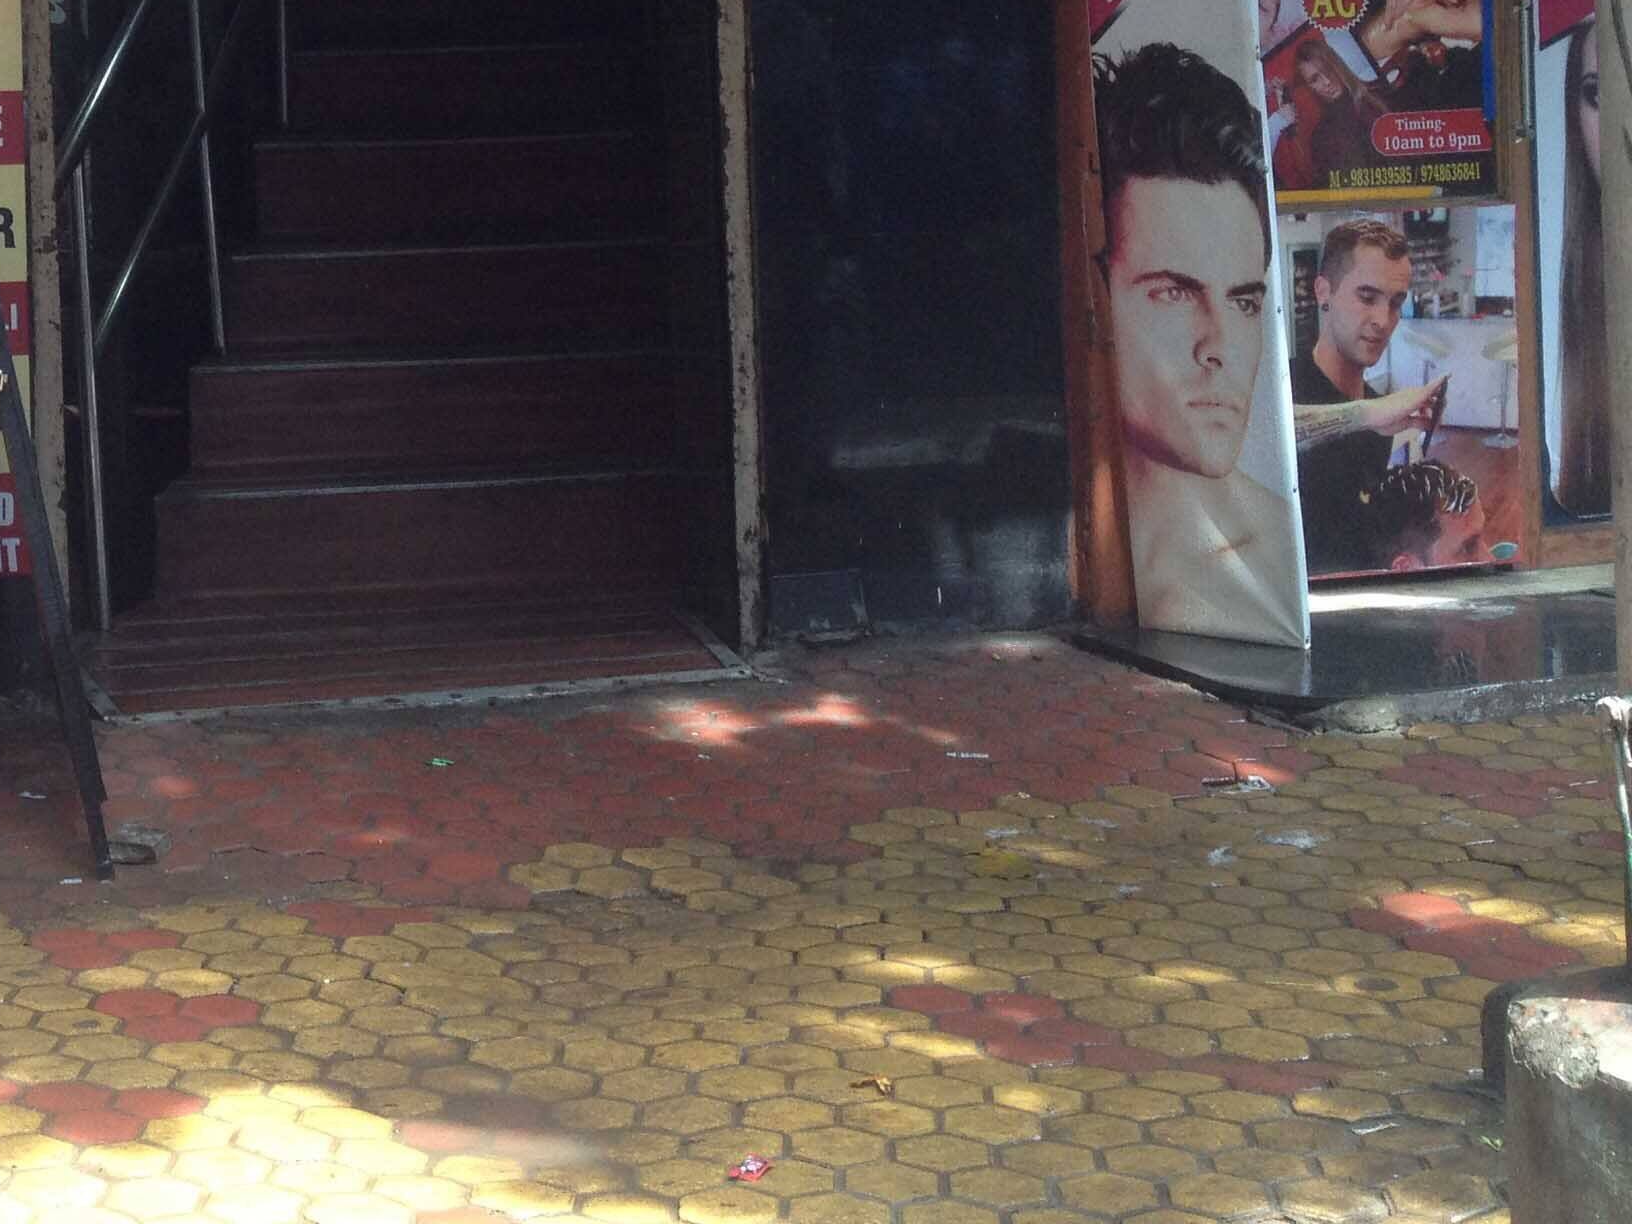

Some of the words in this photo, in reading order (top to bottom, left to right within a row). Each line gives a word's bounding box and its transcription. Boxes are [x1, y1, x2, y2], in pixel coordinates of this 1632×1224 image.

[1383, 136, 1424, 151] 10am
[1429, 136, 1445, 149] to
[1449, 133, 1481, 149] 9pm
